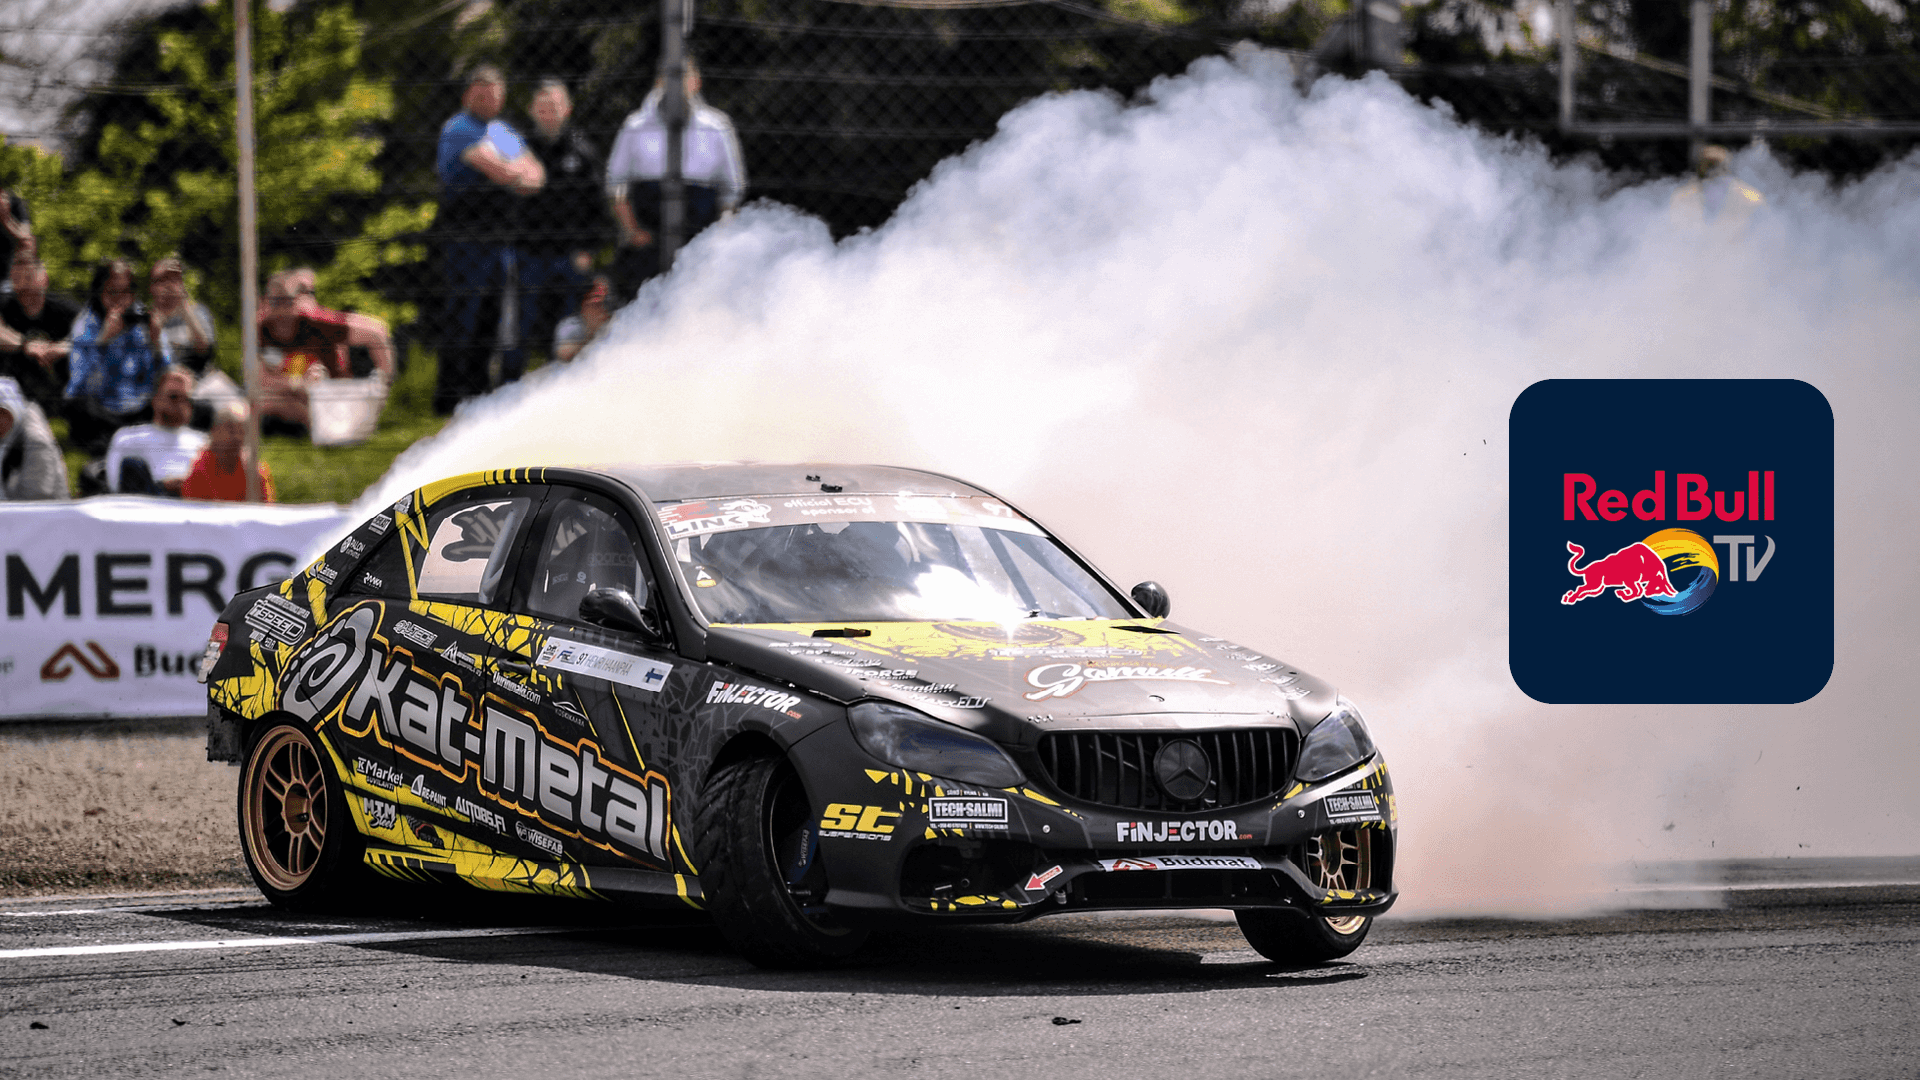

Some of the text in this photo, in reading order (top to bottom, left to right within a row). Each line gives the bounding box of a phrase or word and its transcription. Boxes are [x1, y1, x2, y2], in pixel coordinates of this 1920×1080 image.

[783, 498, 872, 508] official ECU
[801, 506, 876, 517] sponsor of
